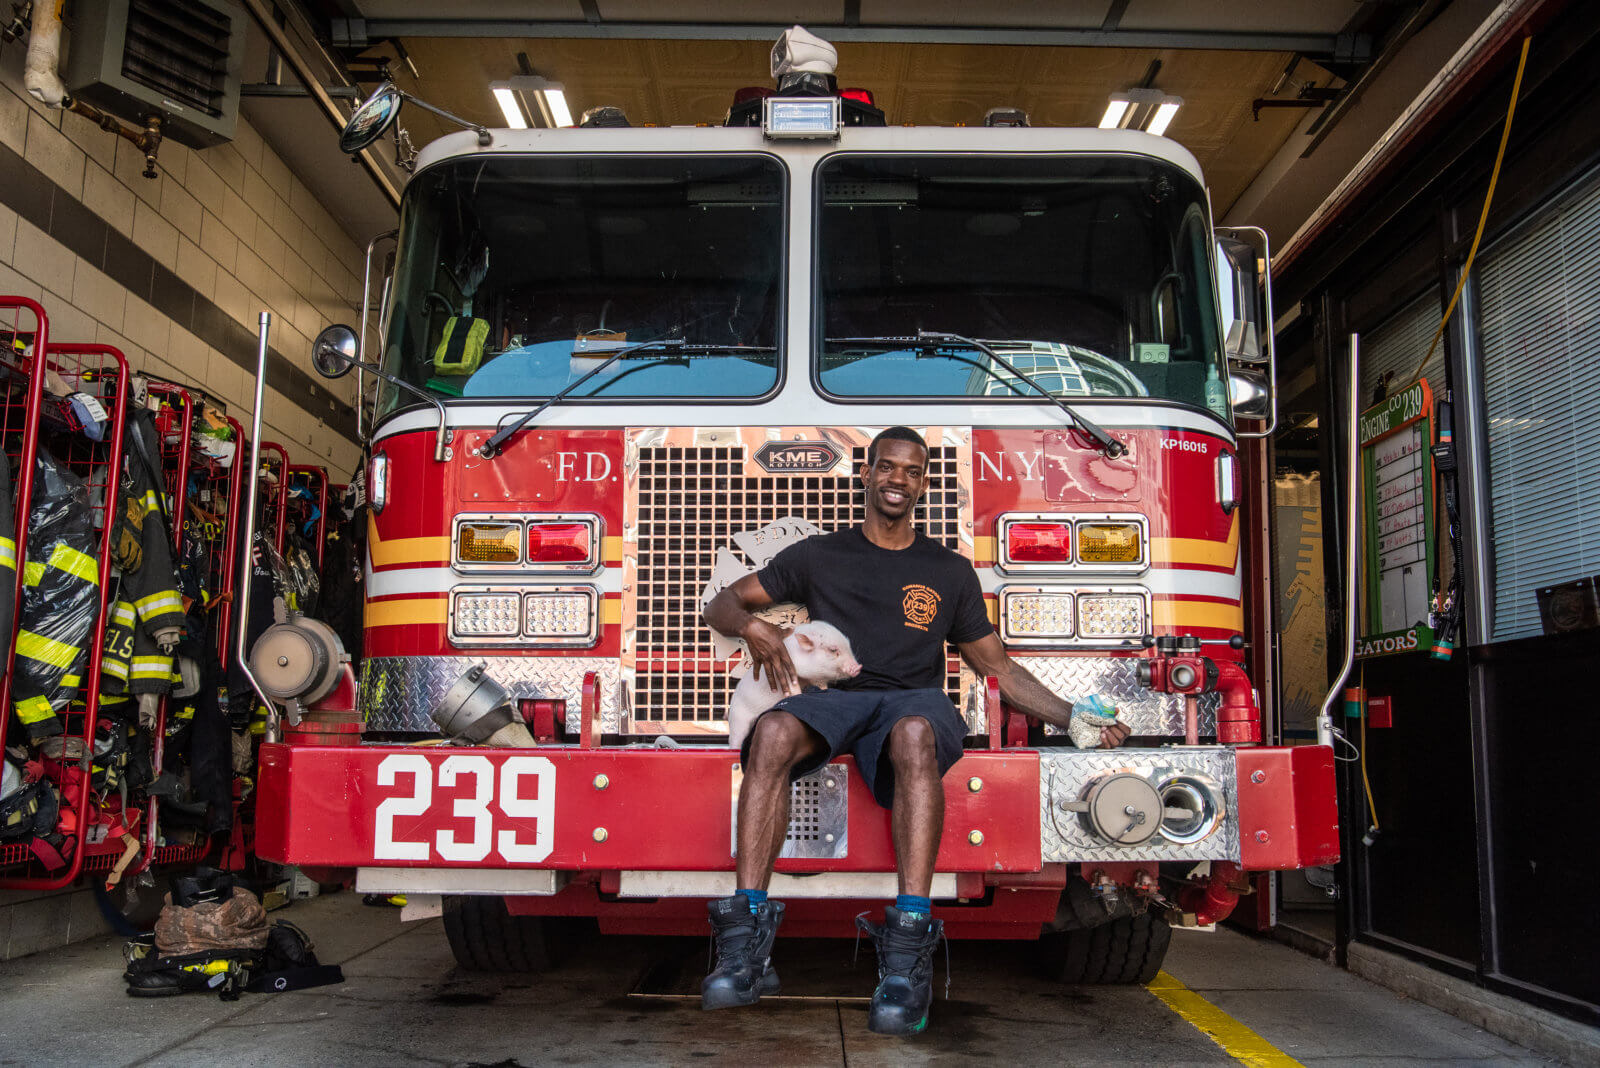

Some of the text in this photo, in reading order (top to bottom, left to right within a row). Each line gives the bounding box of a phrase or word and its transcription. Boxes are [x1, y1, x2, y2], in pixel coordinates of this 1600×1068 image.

[1403, 385, 1422, 421] 239
[769, 451, 822, 462] KME
[1159, 438, 1208, 454] KP16015
[556, 451, 618, 482] F.D.
[975, 451, 1044, 482] N.Y.
[753, 525, 821, 546] FDN
[912, 601, 928, 611] 239
[374, 754, 556, 863] 239
